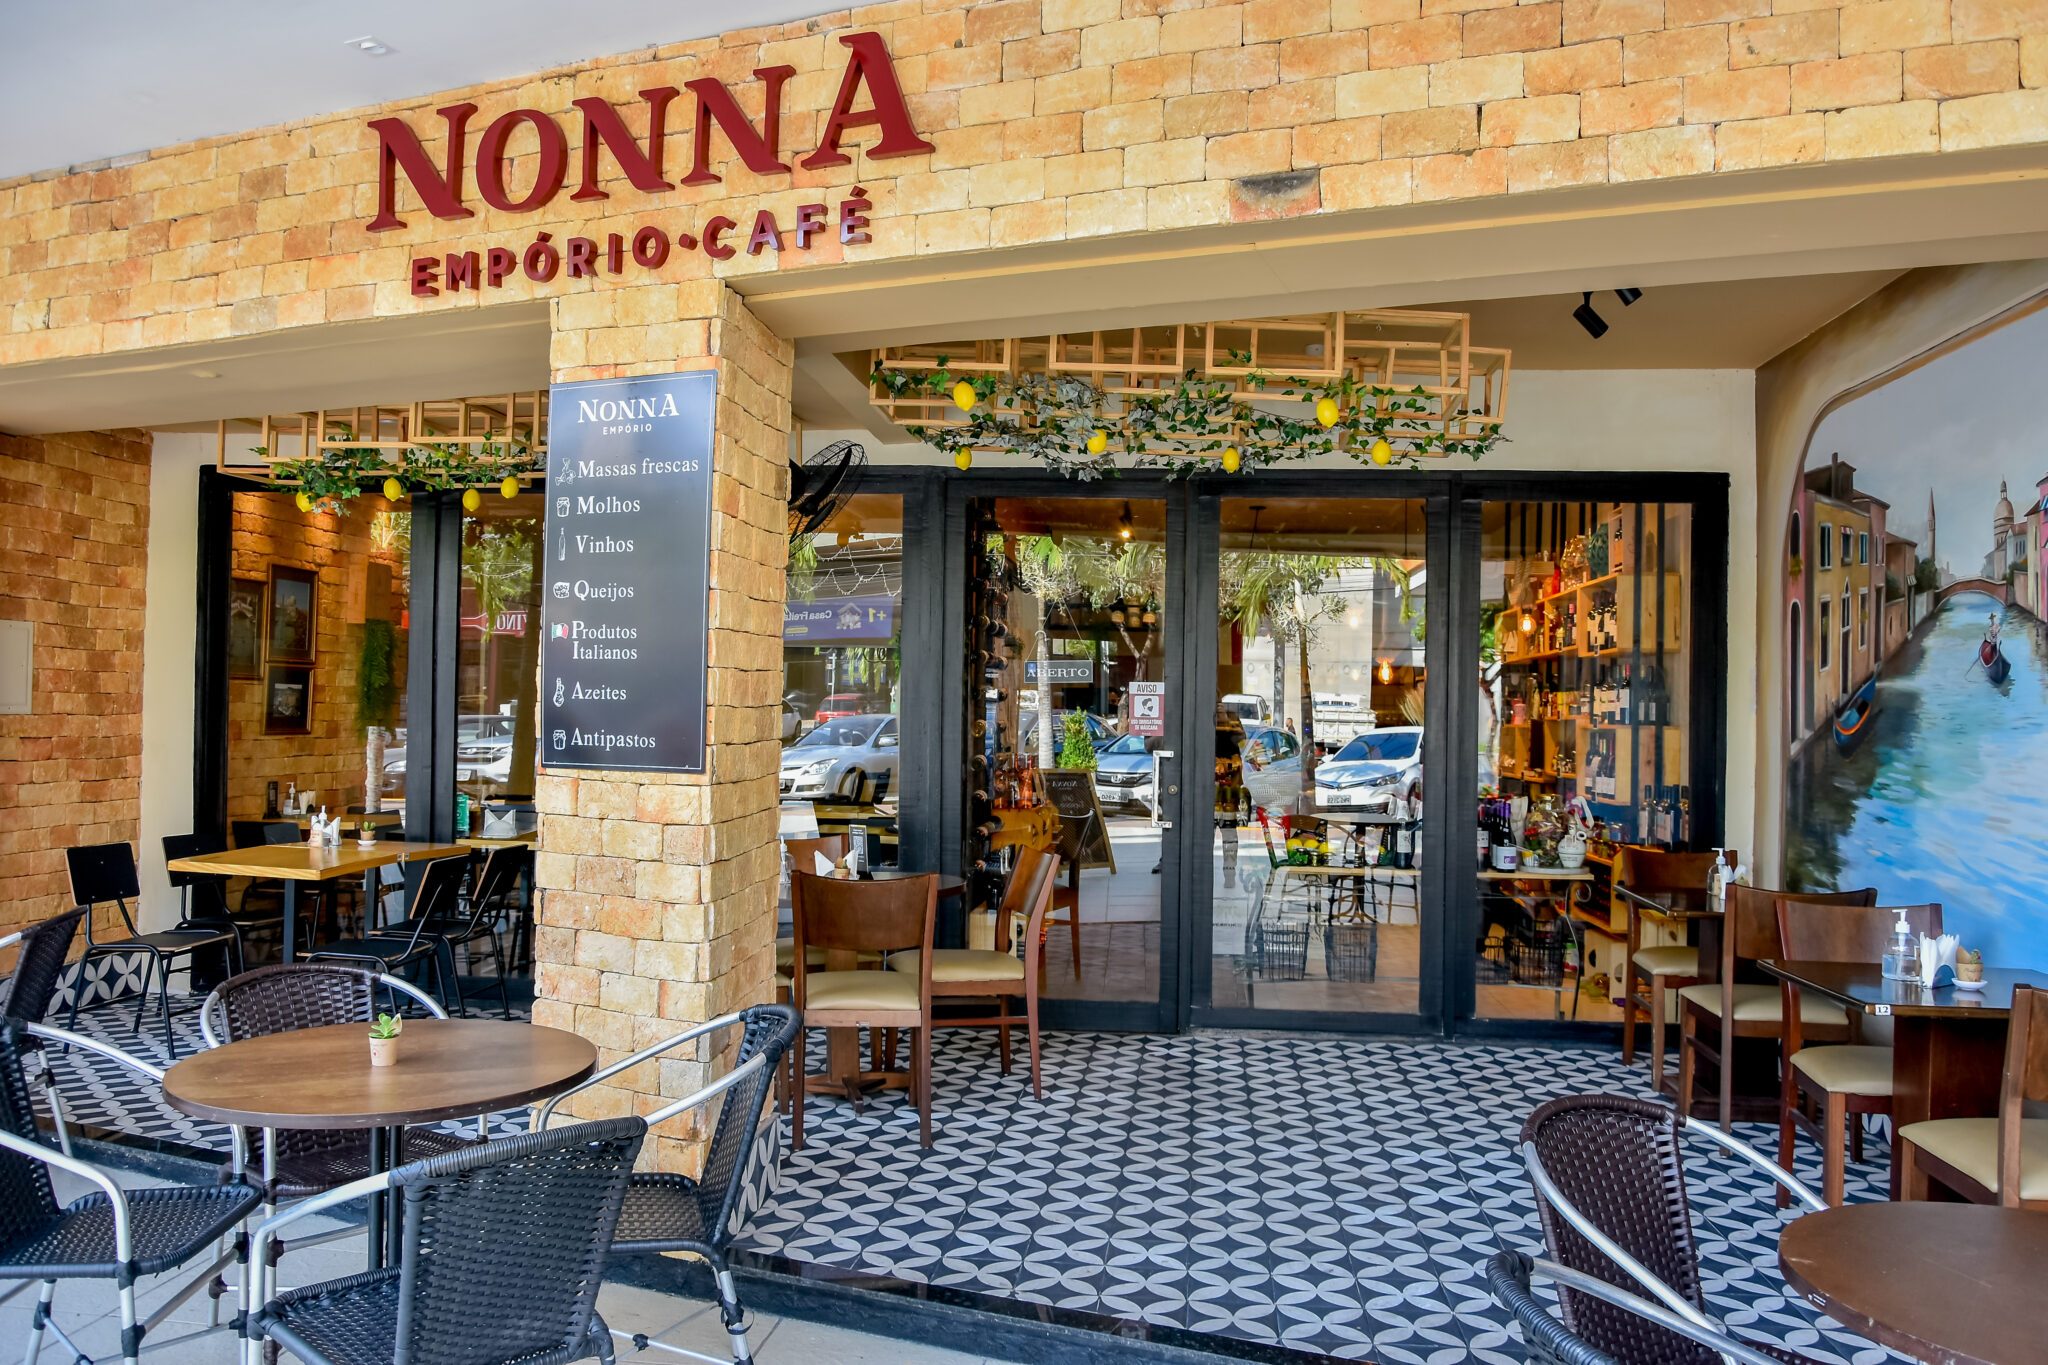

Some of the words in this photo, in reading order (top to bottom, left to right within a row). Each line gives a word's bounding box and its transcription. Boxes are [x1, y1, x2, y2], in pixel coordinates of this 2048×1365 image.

[366, 31, 935, 233] NONNA
[577, 393, 680, 423] NONNA
[602, 423, 652, 435] EMPÓRIO
[577, 459, 637, 478] Massas
[641, 458, 699, 475] frescas
[576, 495, 641, 515] Molhos
[575, 534, 634, 553] Vinhos
[574, 579, 634, 601] Queijos
[572, 620, 638, 639] Produtos
[572, 641, 638, 660] Italianos
[1027, 668, 1089, 678] ABERTO
[571, 681, 627, 700] Azeites
[1136, 684, 1157, 693] AVISO
[570, 727, 656, 751] Antipastos
